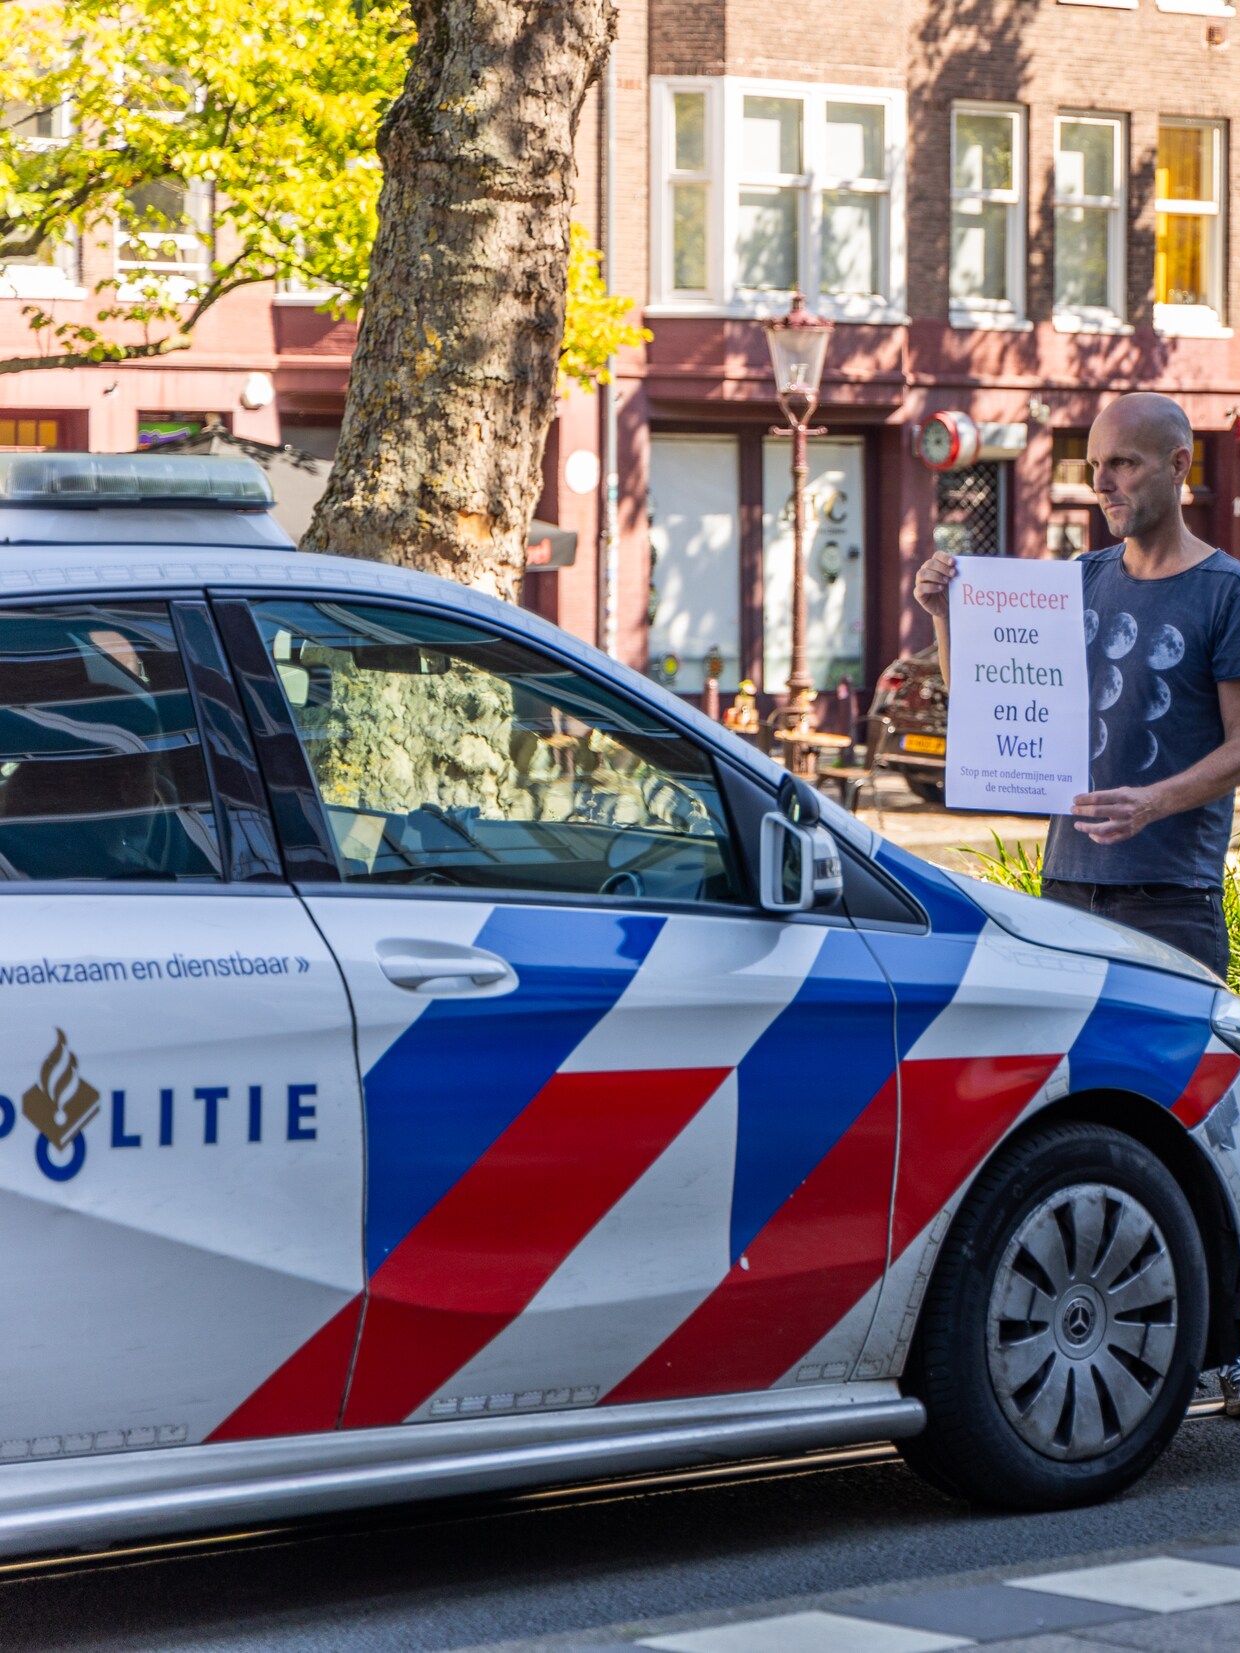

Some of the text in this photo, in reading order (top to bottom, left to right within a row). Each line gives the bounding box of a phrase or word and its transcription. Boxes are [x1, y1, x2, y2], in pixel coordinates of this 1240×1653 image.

[962, 583, 1069, 613] Respecteer
[993, 626, 1039, 645] onze
[974, 658, 1064, 687] rechten
[993, 700, 1049, 723] en de
[996, 734, 1043, 759] Wet!
[960, 766, 1073, 783] Stop met ondermijnen van
[985, 782, 1048, 796] de rechtsstaat.
[0, 951, 290, 985] waakzaam en dienstbaar
